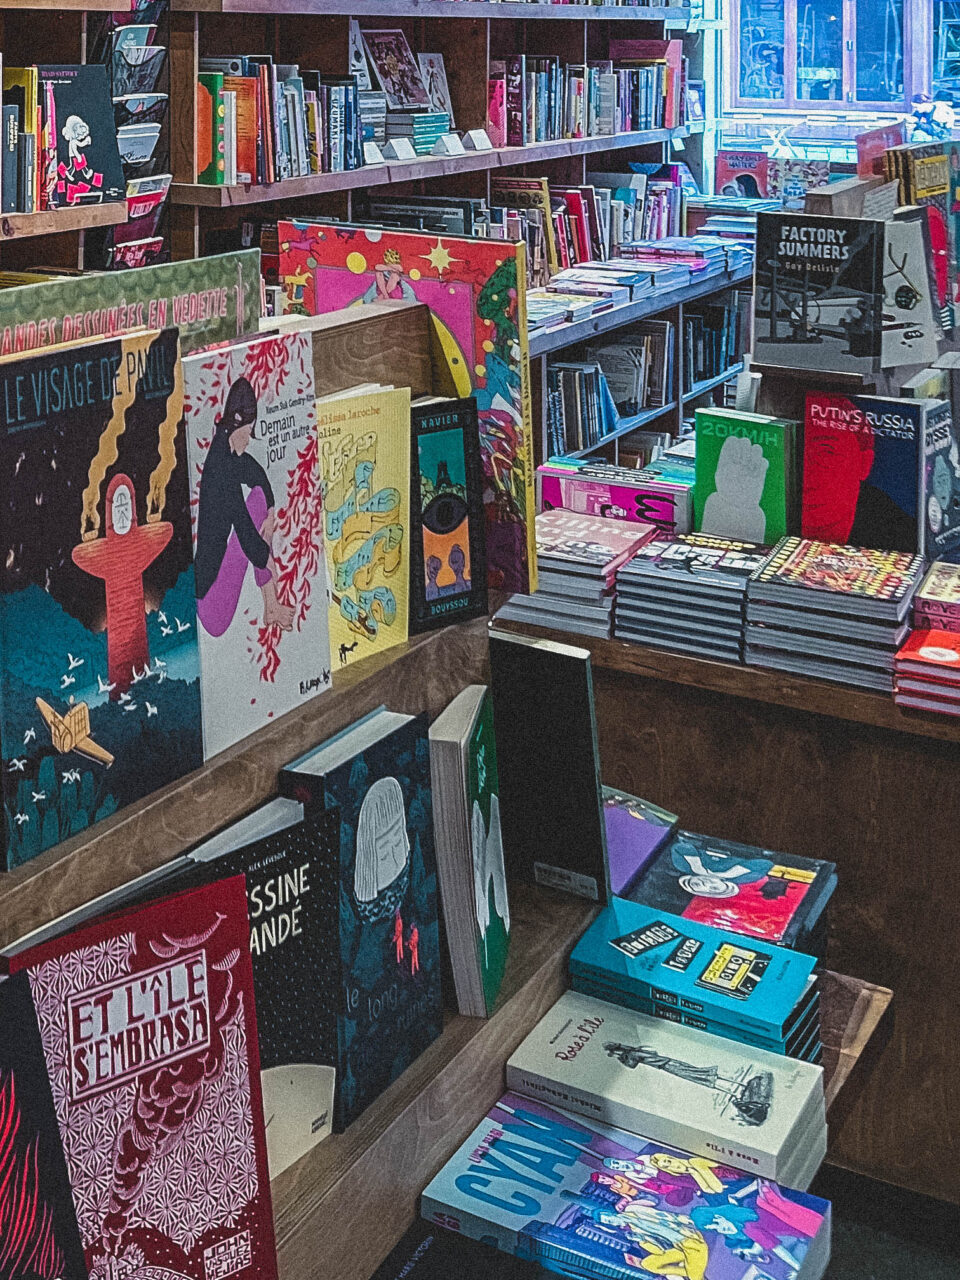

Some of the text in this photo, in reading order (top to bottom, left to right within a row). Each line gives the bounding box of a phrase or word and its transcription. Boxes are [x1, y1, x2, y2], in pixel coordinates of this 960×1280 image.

[330, 98, 340, 140] UZUMAKI
[781, 225, 847, 245] FACTORY
[778, 242, 849, 261] SUMMERS
[62, 300, 144, 342] DESSINÉES
[148, 296, 167, 329] EN
[172, 287, 228, 322] VEDETTE
[4, 376, 26, 424] LE
[32, 364, 92, 416] VISAGE
[100, 356, 121, 400] DE
[260, 414, 295, 437] Demain
[421, 414, 458, 429] XAVIER
[810, 404, 915, 432] PUTIN'S RUSSIA
[812, 418, 828, 429] THE
[829, 420, 847, 431] RISE
[849, 423, 861, 433] OF
[871, 427, 915, 441] DICTATOR
[268, 424, 310, 448] est un autre
[266, 446, 287, 470] jour
[431, 598, 469, 613] BOUYSSOU
[73, 957, 206, 1046] ET L'ÎLE
[71, 1004, 209, 1090] S'EMBRASA
[455, 1120, 593, 1217] CYAN
[206, 1231, 250, 1260] JOHN
